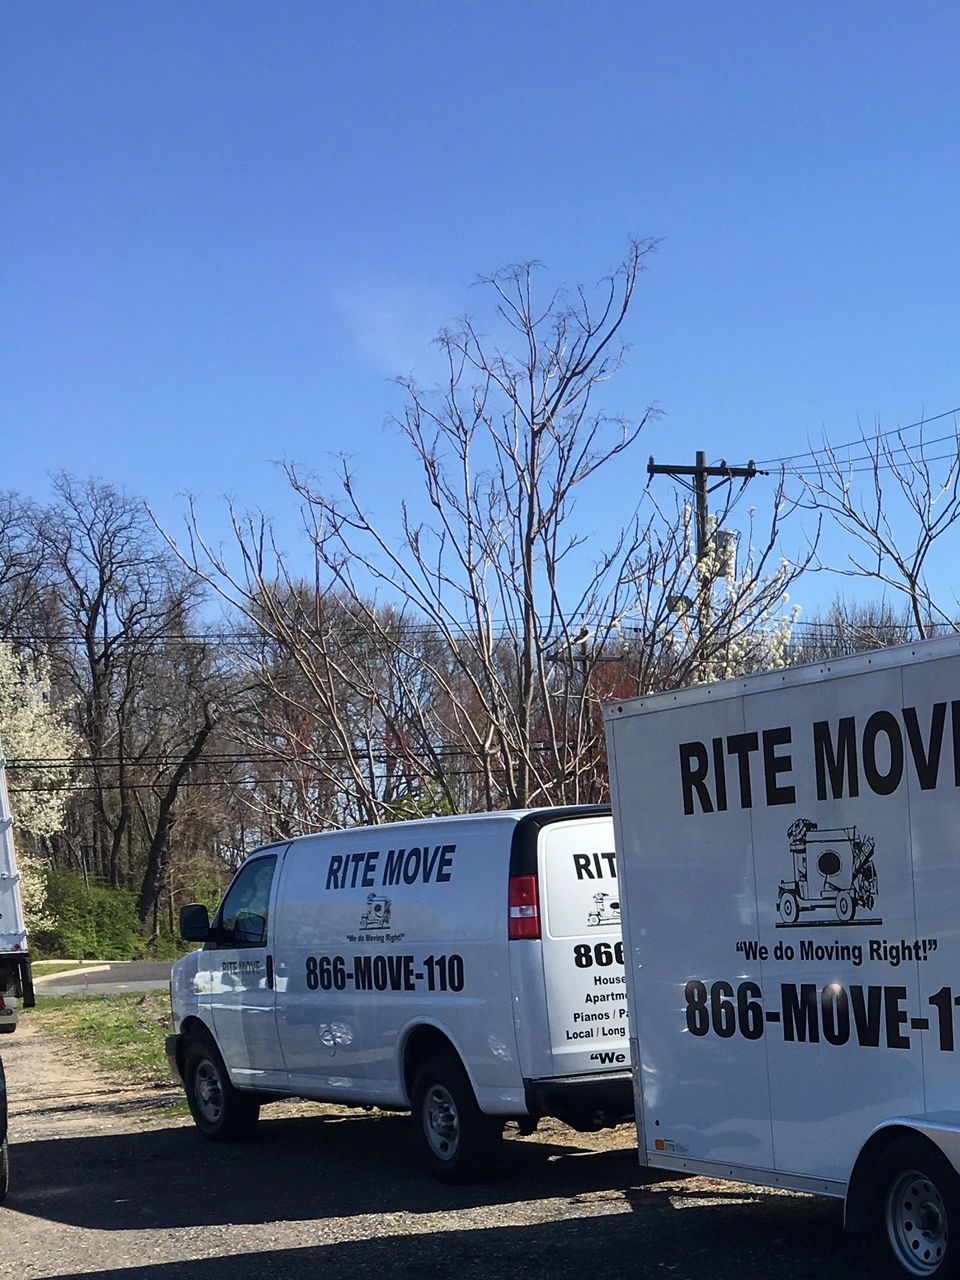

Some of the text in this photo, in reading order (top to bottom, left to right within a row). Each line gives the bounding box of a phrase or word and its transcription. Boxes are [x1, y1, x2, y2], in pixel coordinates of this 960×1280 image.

[679, 726, 796, 816] RITE
[325, 844, 457, 891] RITE MOVE
[366, 934, 385, 943] Moving
[773, 941, 794, 961] do
[800, 940, 863, 966] Moving
[306, 954, 464, 992] 866-MOVE-110
[573, 1012, 610, 1023] Pianos
[566, 1028, 594, 1040] Local
[602, 1027, 626, 1037] Long
